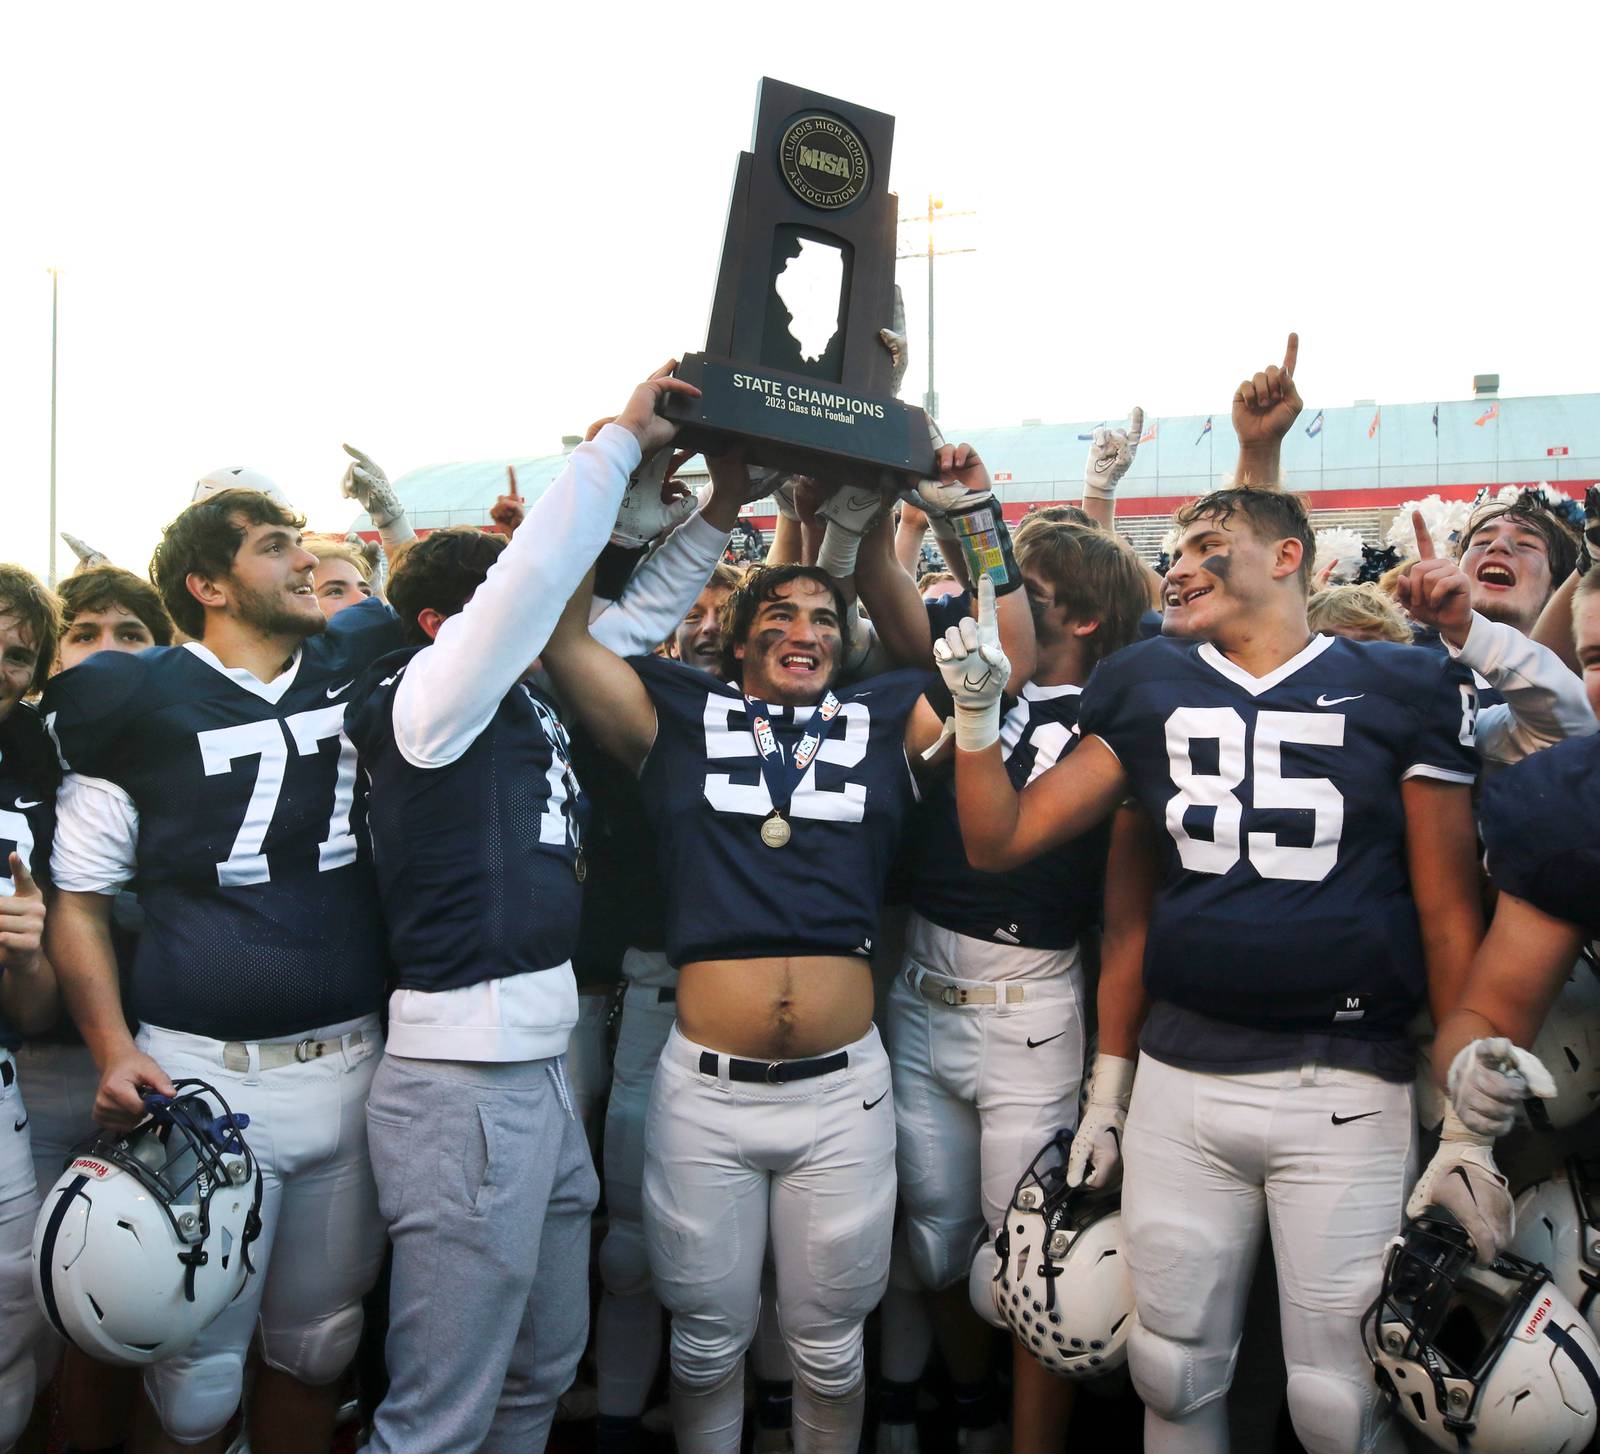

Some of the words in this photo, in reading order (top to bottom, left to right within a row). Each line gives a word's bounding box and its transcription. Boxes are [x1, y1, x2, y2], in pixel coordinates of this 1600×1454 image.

[784, 121, 813, 161] ILLINOIS
[815, 121, 842, 136] HIGH
[843, 134, 864, 180] SCHOOL
[788, 171, 856, 204] ASSOCIATION
[733, 373, 783, 397] STATE
[787, 385, 885, 419] CHAMPIONS
[765, 395, 786, 410] 2023
[788, 400, 809, 415] Class
[811, 405, 823, 418] 6A
[825, 408, 855, 425] Football
[703, 691, 871, 823] 52
[197, 702, 359, 888] 77
[1164, 706, 1346, 882] 85
[863, 937, 873, 950] M
[1008, 923, 1019, 933] S
[1346, 997, 1360, 1009] M
